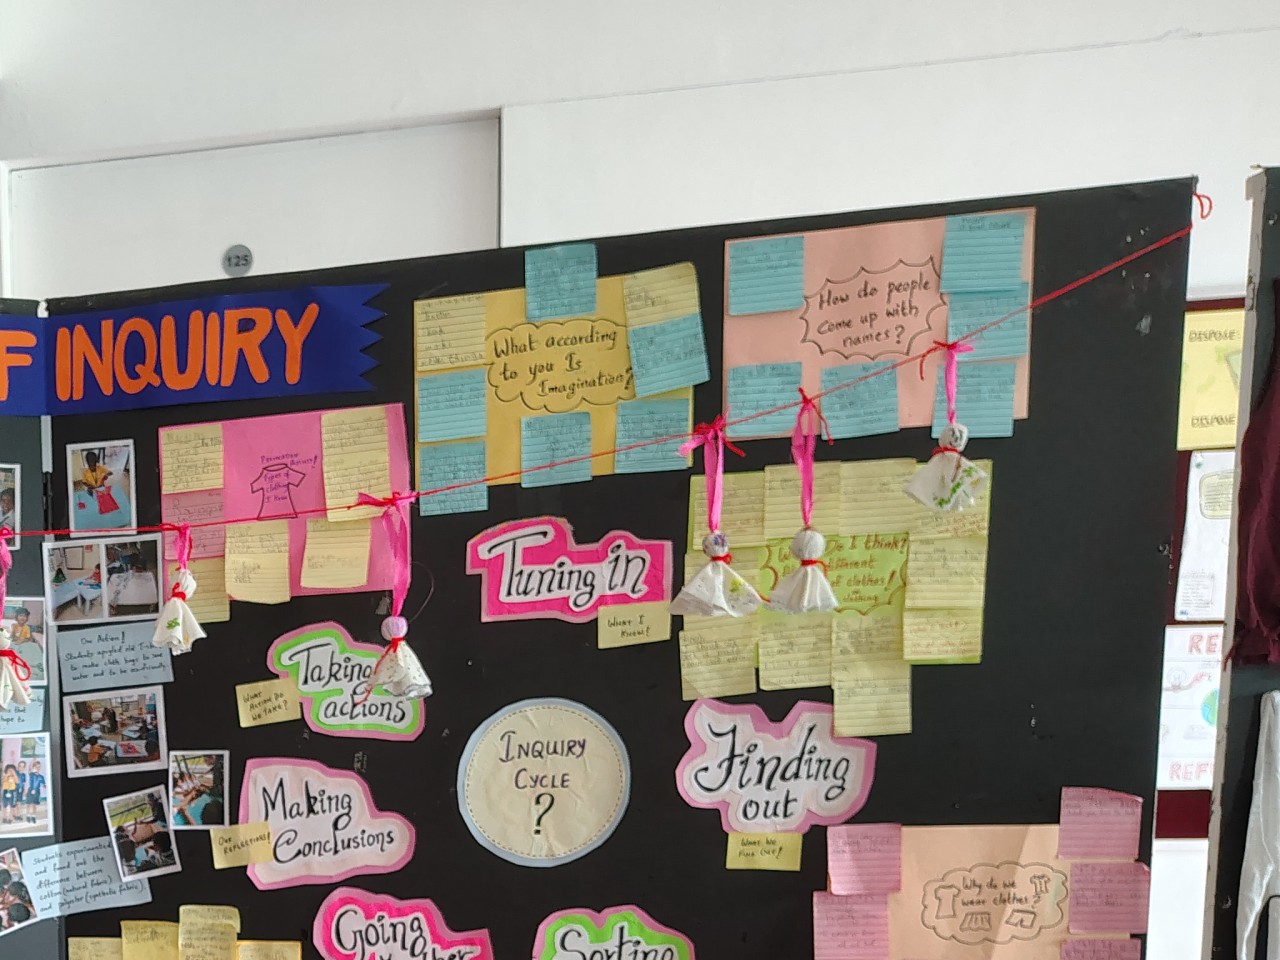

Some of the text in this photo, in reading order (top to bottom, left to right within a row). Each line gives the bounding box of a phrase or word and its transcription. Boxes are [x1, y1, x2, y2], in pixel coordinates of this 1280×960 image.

[227, 255, 249, 267] 125
[819, 272, 930, 310] How do people
[860, 312, 877, 328] up
[886, 300, 919, 318] with
[56, 303, 320, 401] INQUIRY
[494, 324, 617, 358] What according
[500, 353, 582, 385] to you Is
[537, 367, 634, 399] Imagination?
[488, 531, 647, 608] Tuning in
[289, 643, 373, 694] Taking
[324, 694, 405, 723] actions
[499, 731, 586, 762] INQUIRY
[694, 723, 849, 802] Finding
[515, 768, 570, 789] CYCLE
[263, 778, 352, 825] Making
[534, 793, 555, 835] ?
[743, 791, 797, 821] out
[273, 815, 394, 863] Conclusions
[963, 876, 1016, 896] Why do we
